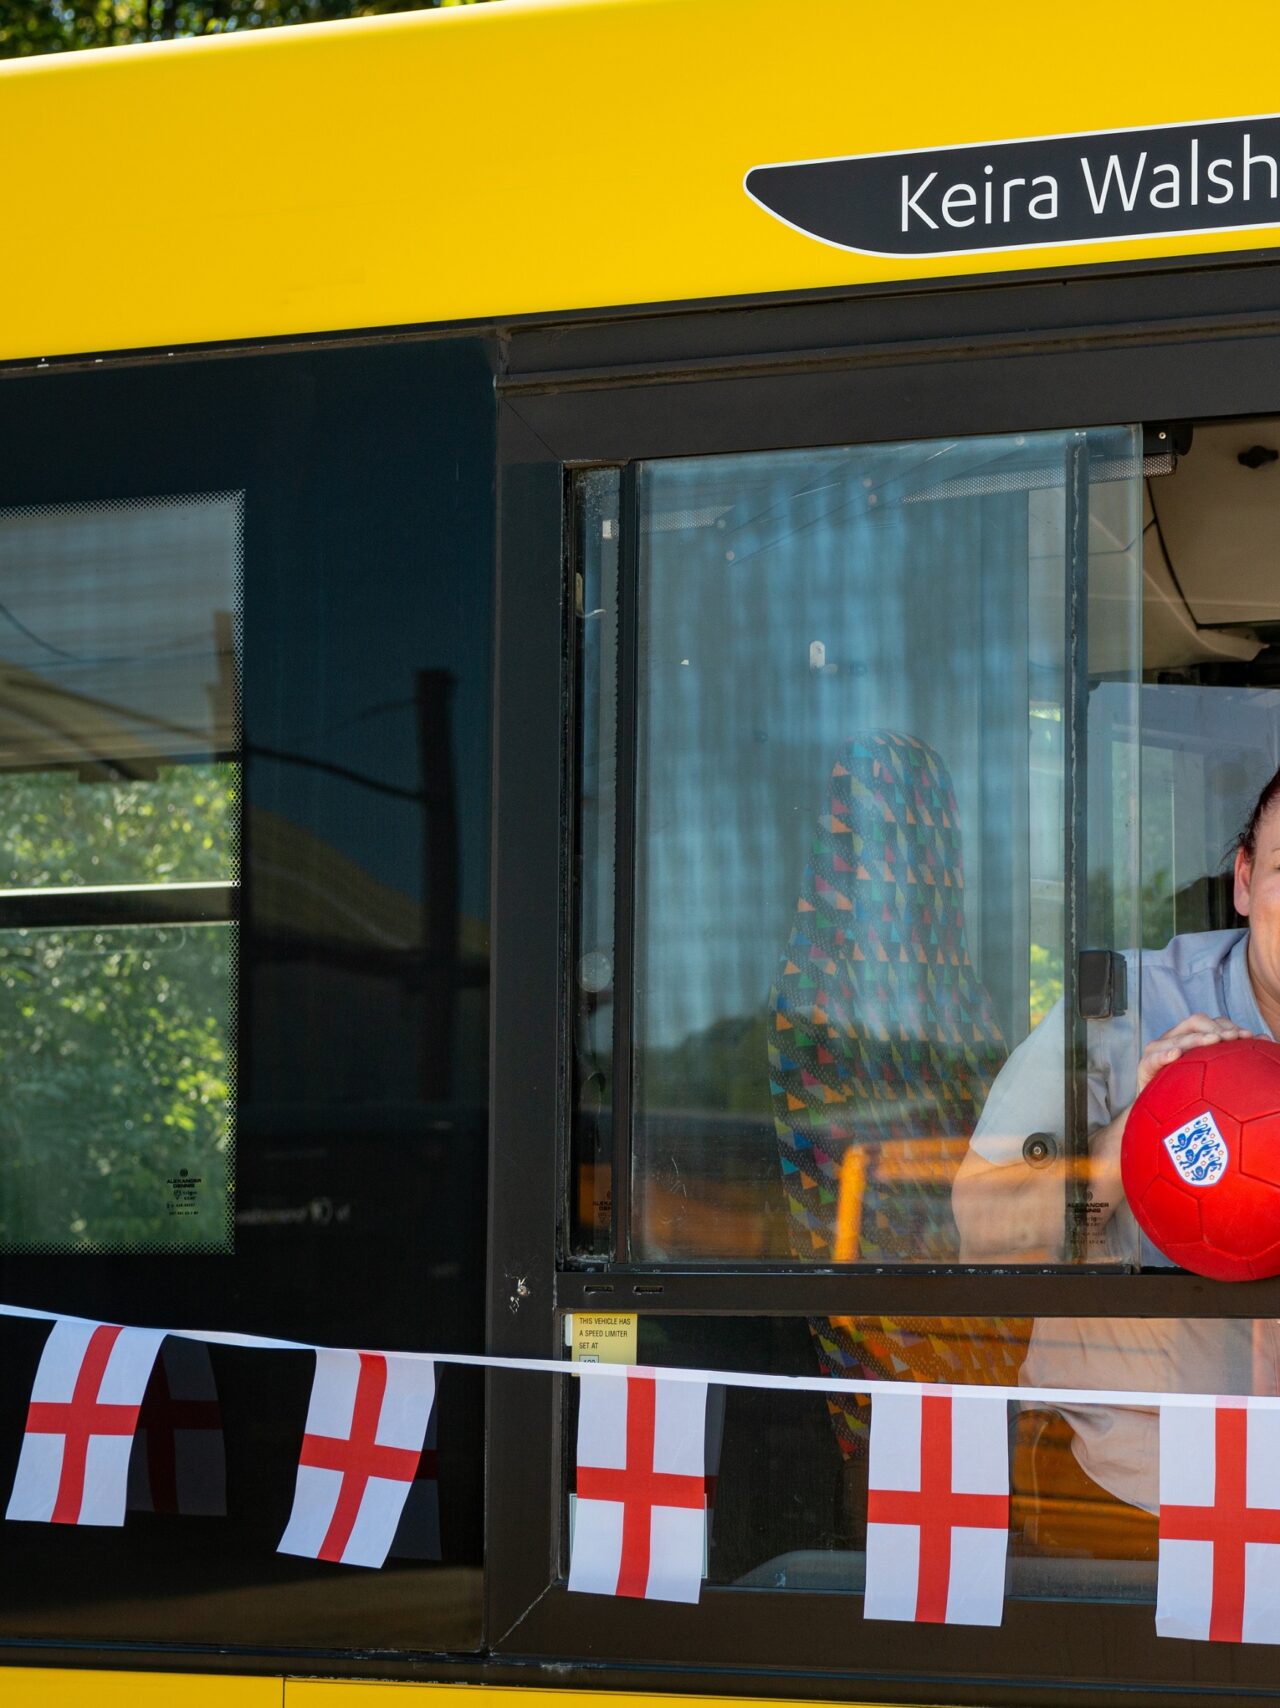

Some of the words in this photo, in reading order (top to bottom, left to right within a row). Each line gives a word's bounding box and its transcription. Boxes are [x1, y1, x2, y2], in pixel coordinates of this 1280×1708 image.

[900, 165, 1059, 233] Keira
[1081, 133, 1278, 214] Walsh
[579, 1317, 593, 1325] THIS
[594, 1317, 619, 1325] VEHICLE
[619, 1317, 631, 1326] HAS
[604, 1330, 628, 1338] LIMITER
